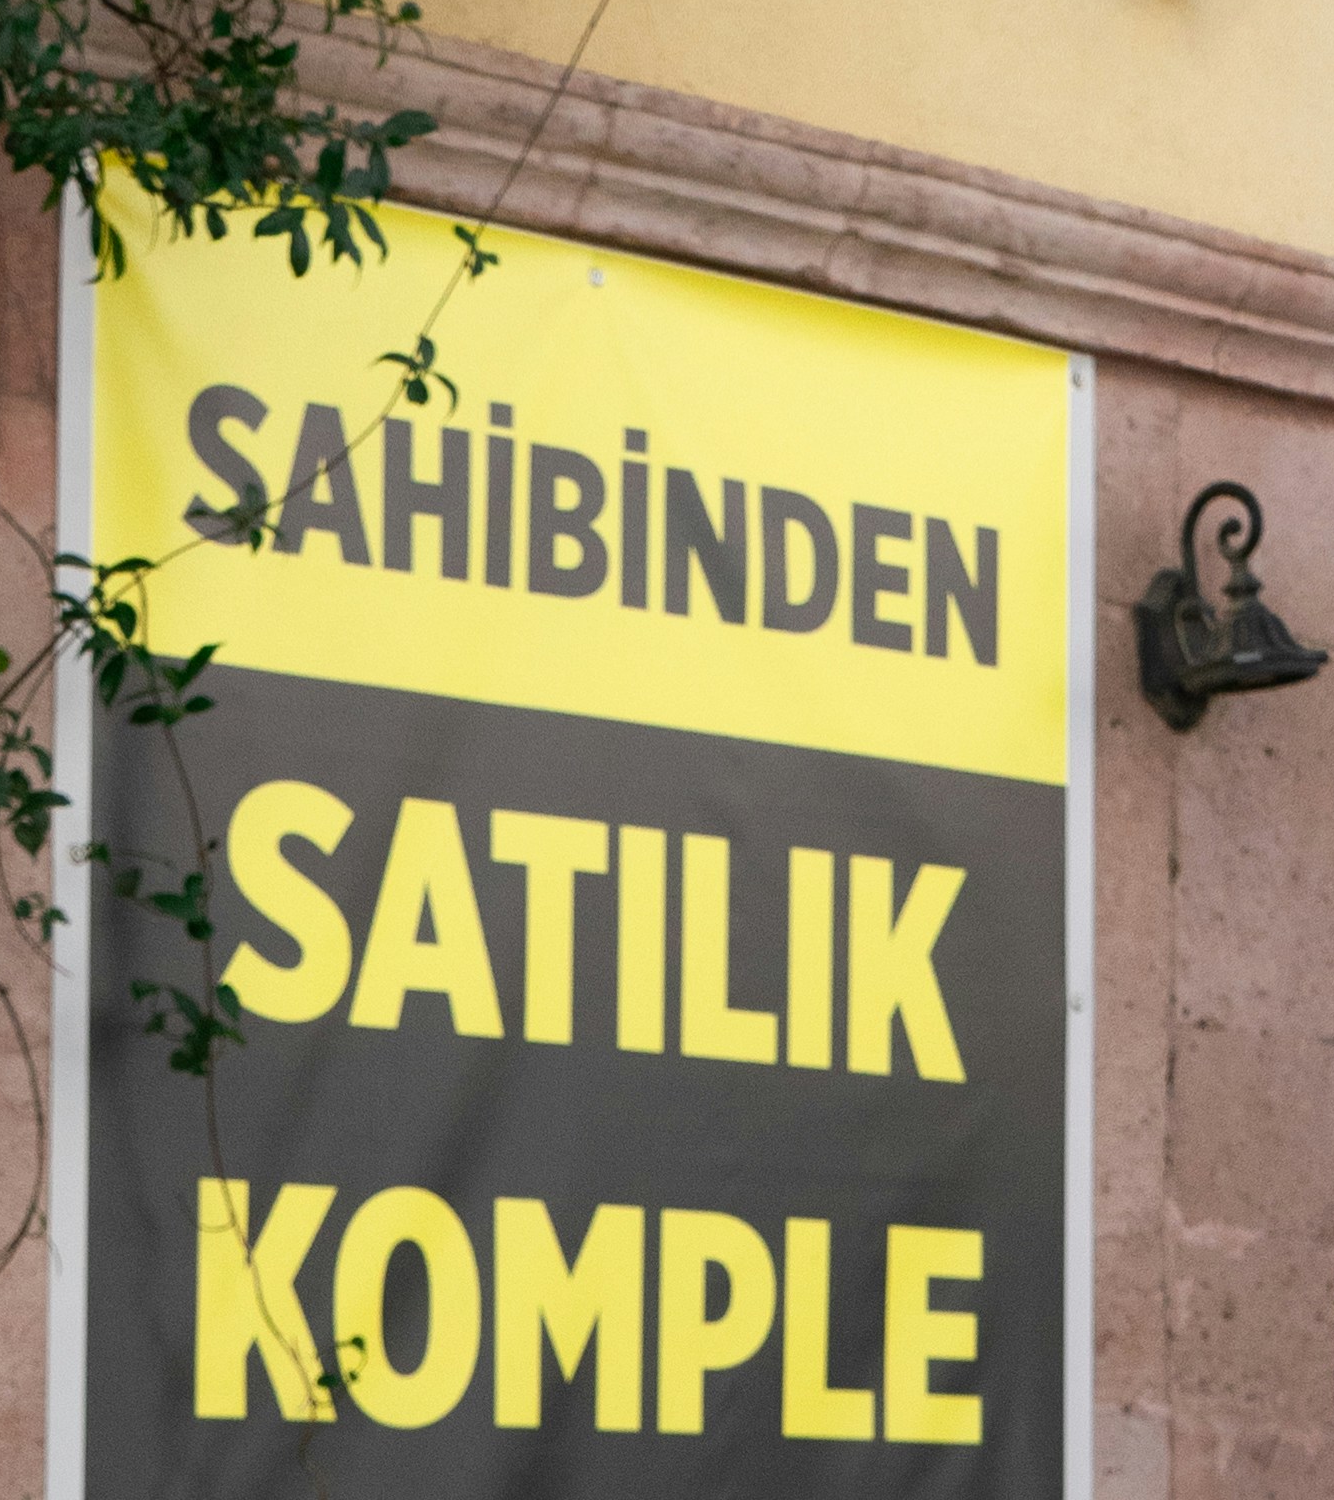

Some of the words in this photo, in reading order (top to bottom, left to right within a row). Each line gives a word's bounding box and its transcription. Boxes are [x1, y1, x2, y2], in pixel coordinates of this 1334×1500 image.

[182, 384, 1000, 668] SAHİBİNDEN
[219, 780, 966, 1084] SATILIK
[194, 1177, 985, 1446] KOMPLE
